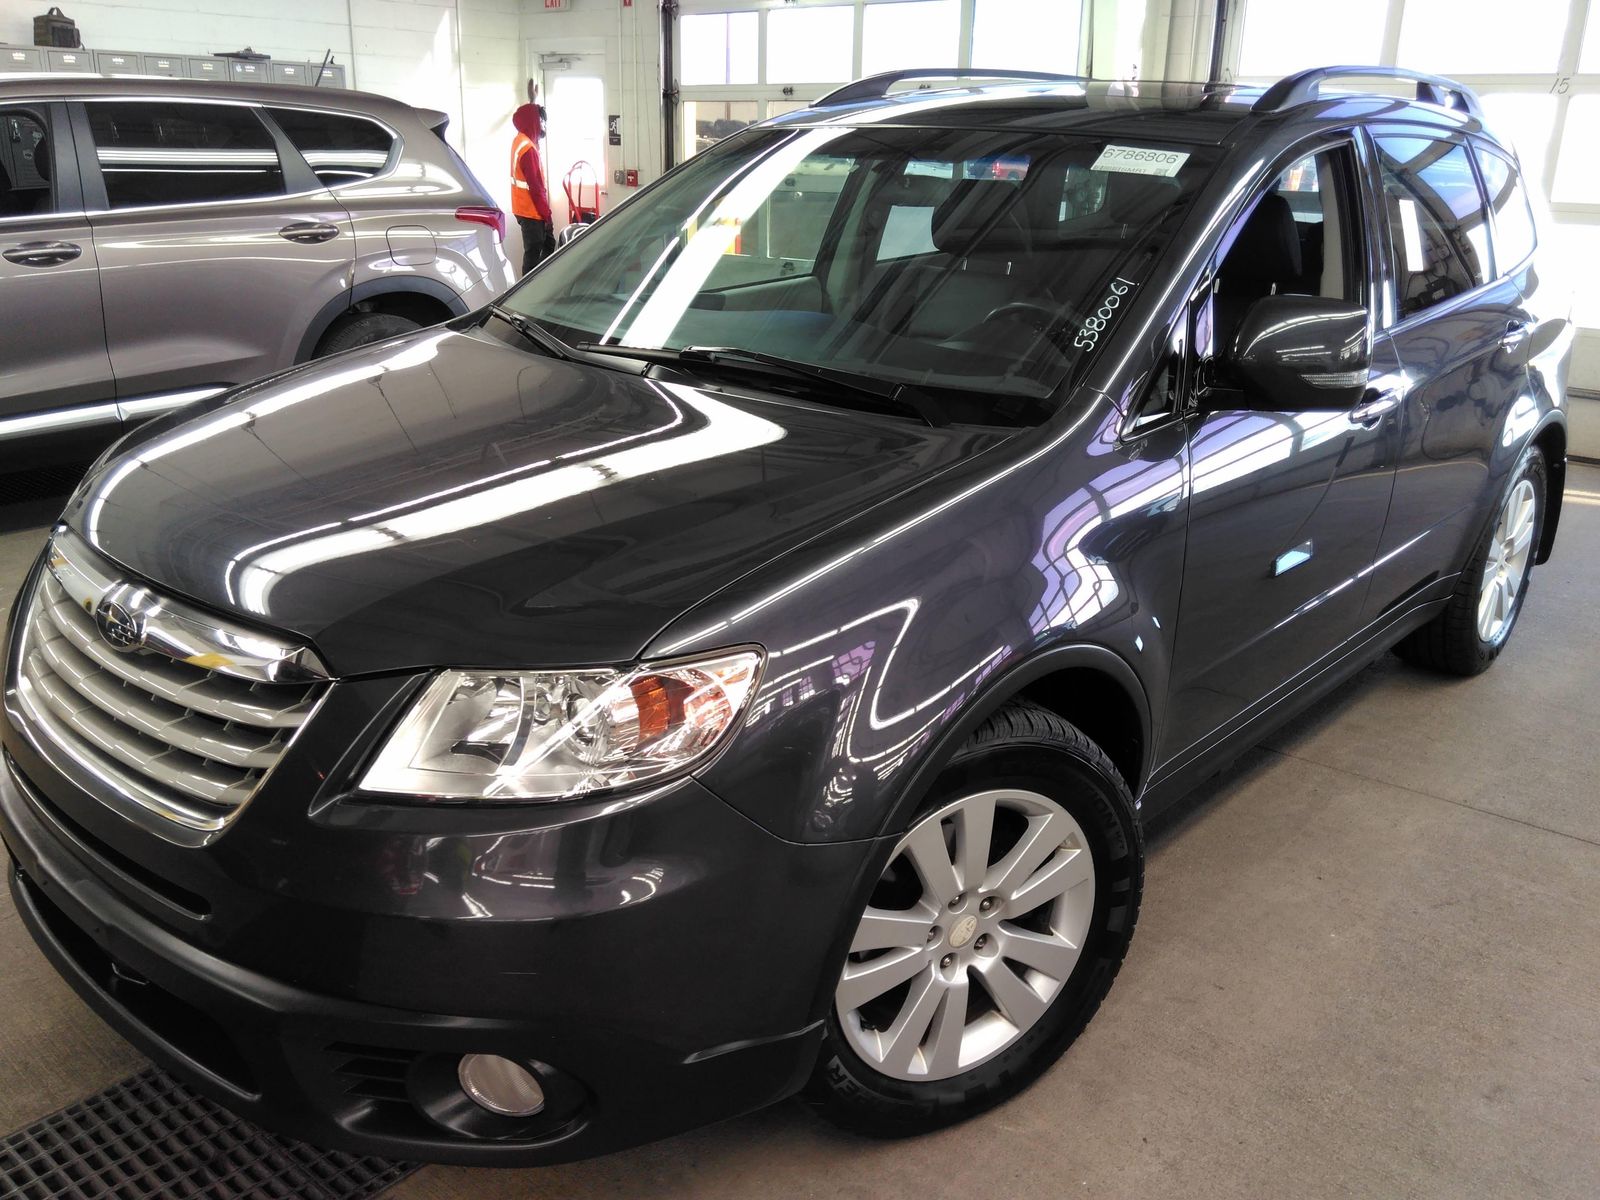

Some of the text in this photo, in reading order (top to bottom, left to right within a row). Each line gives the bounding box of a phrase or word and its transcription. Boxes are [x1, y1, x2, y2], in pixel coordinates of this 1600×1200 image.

[1548, 77, 1571, 95] 15
[1103, 148, 1179, 164] 6786806
[1074, 277, 1136, 352] 5380061
